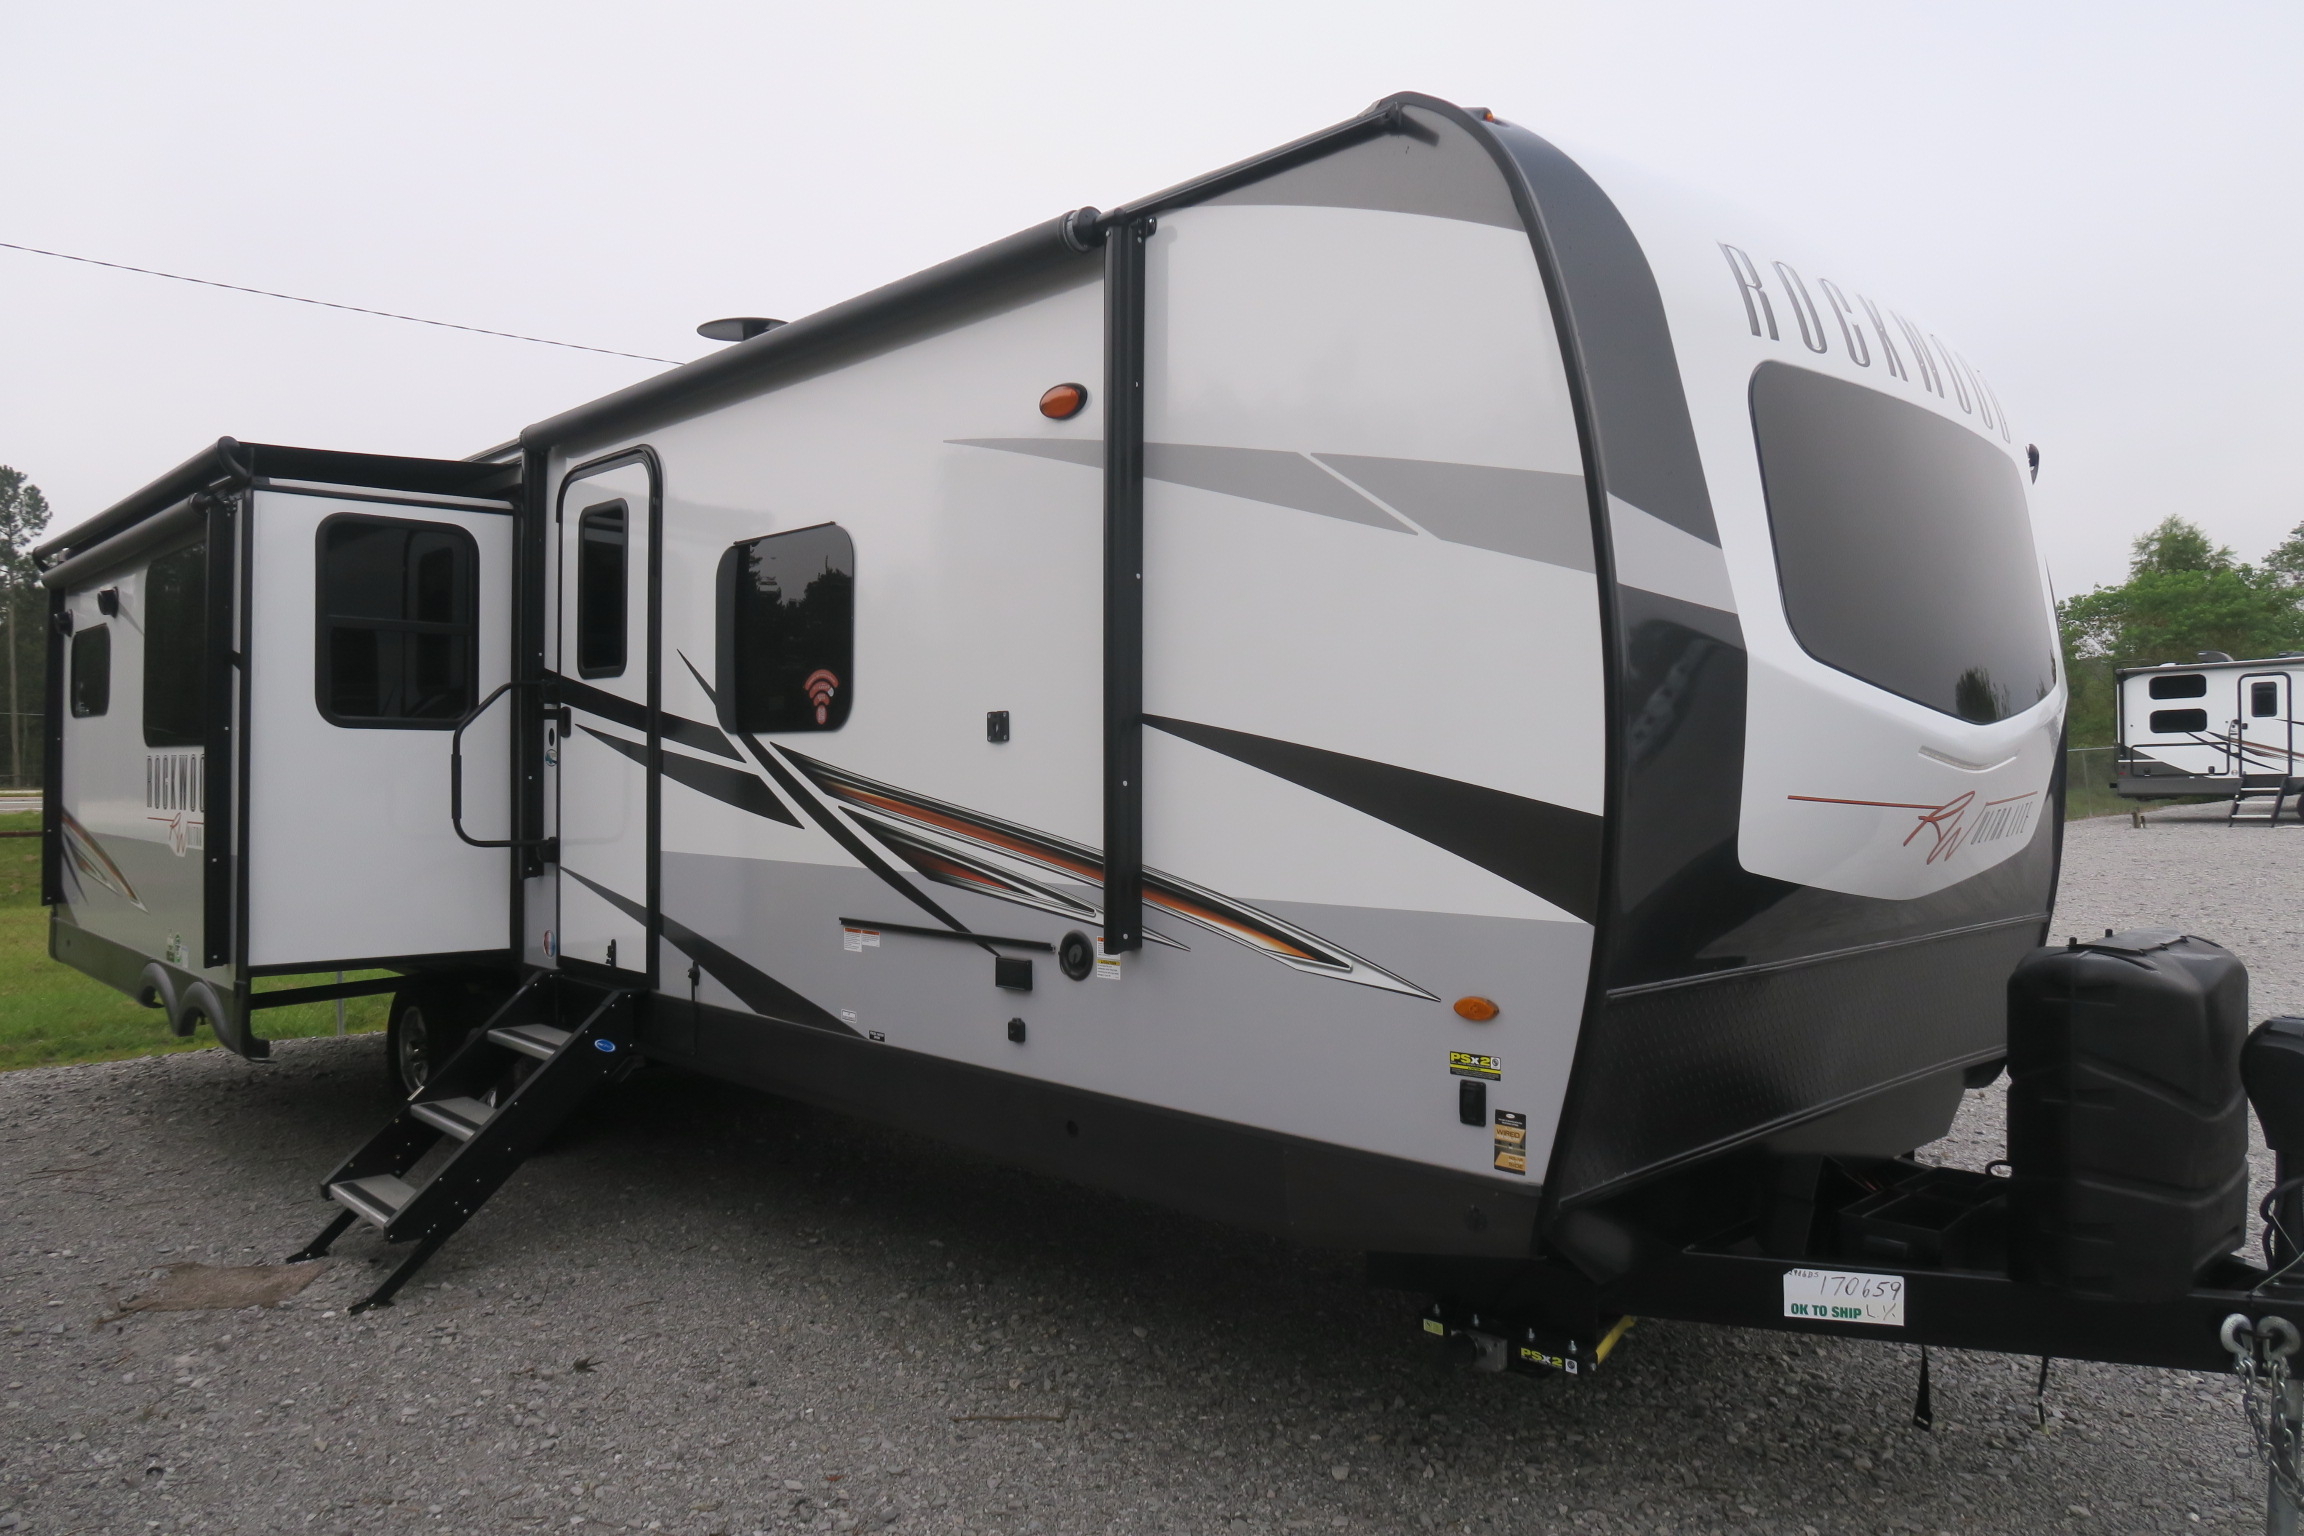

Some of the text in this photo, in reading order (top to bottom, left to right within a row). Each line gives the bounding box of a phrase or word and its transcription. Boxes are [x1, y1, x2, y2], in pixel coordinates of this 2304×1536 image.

[1717, 240, 2011, 444] ROCKWOOD
[146, 753, 205, 813] ROCKWOO
[1496, 1128, 1521, 1139] WIRED
[1820, 1275, 1902, 1301] 170659
[1790, 1303, 1862, 1319] OK TO SHIP
